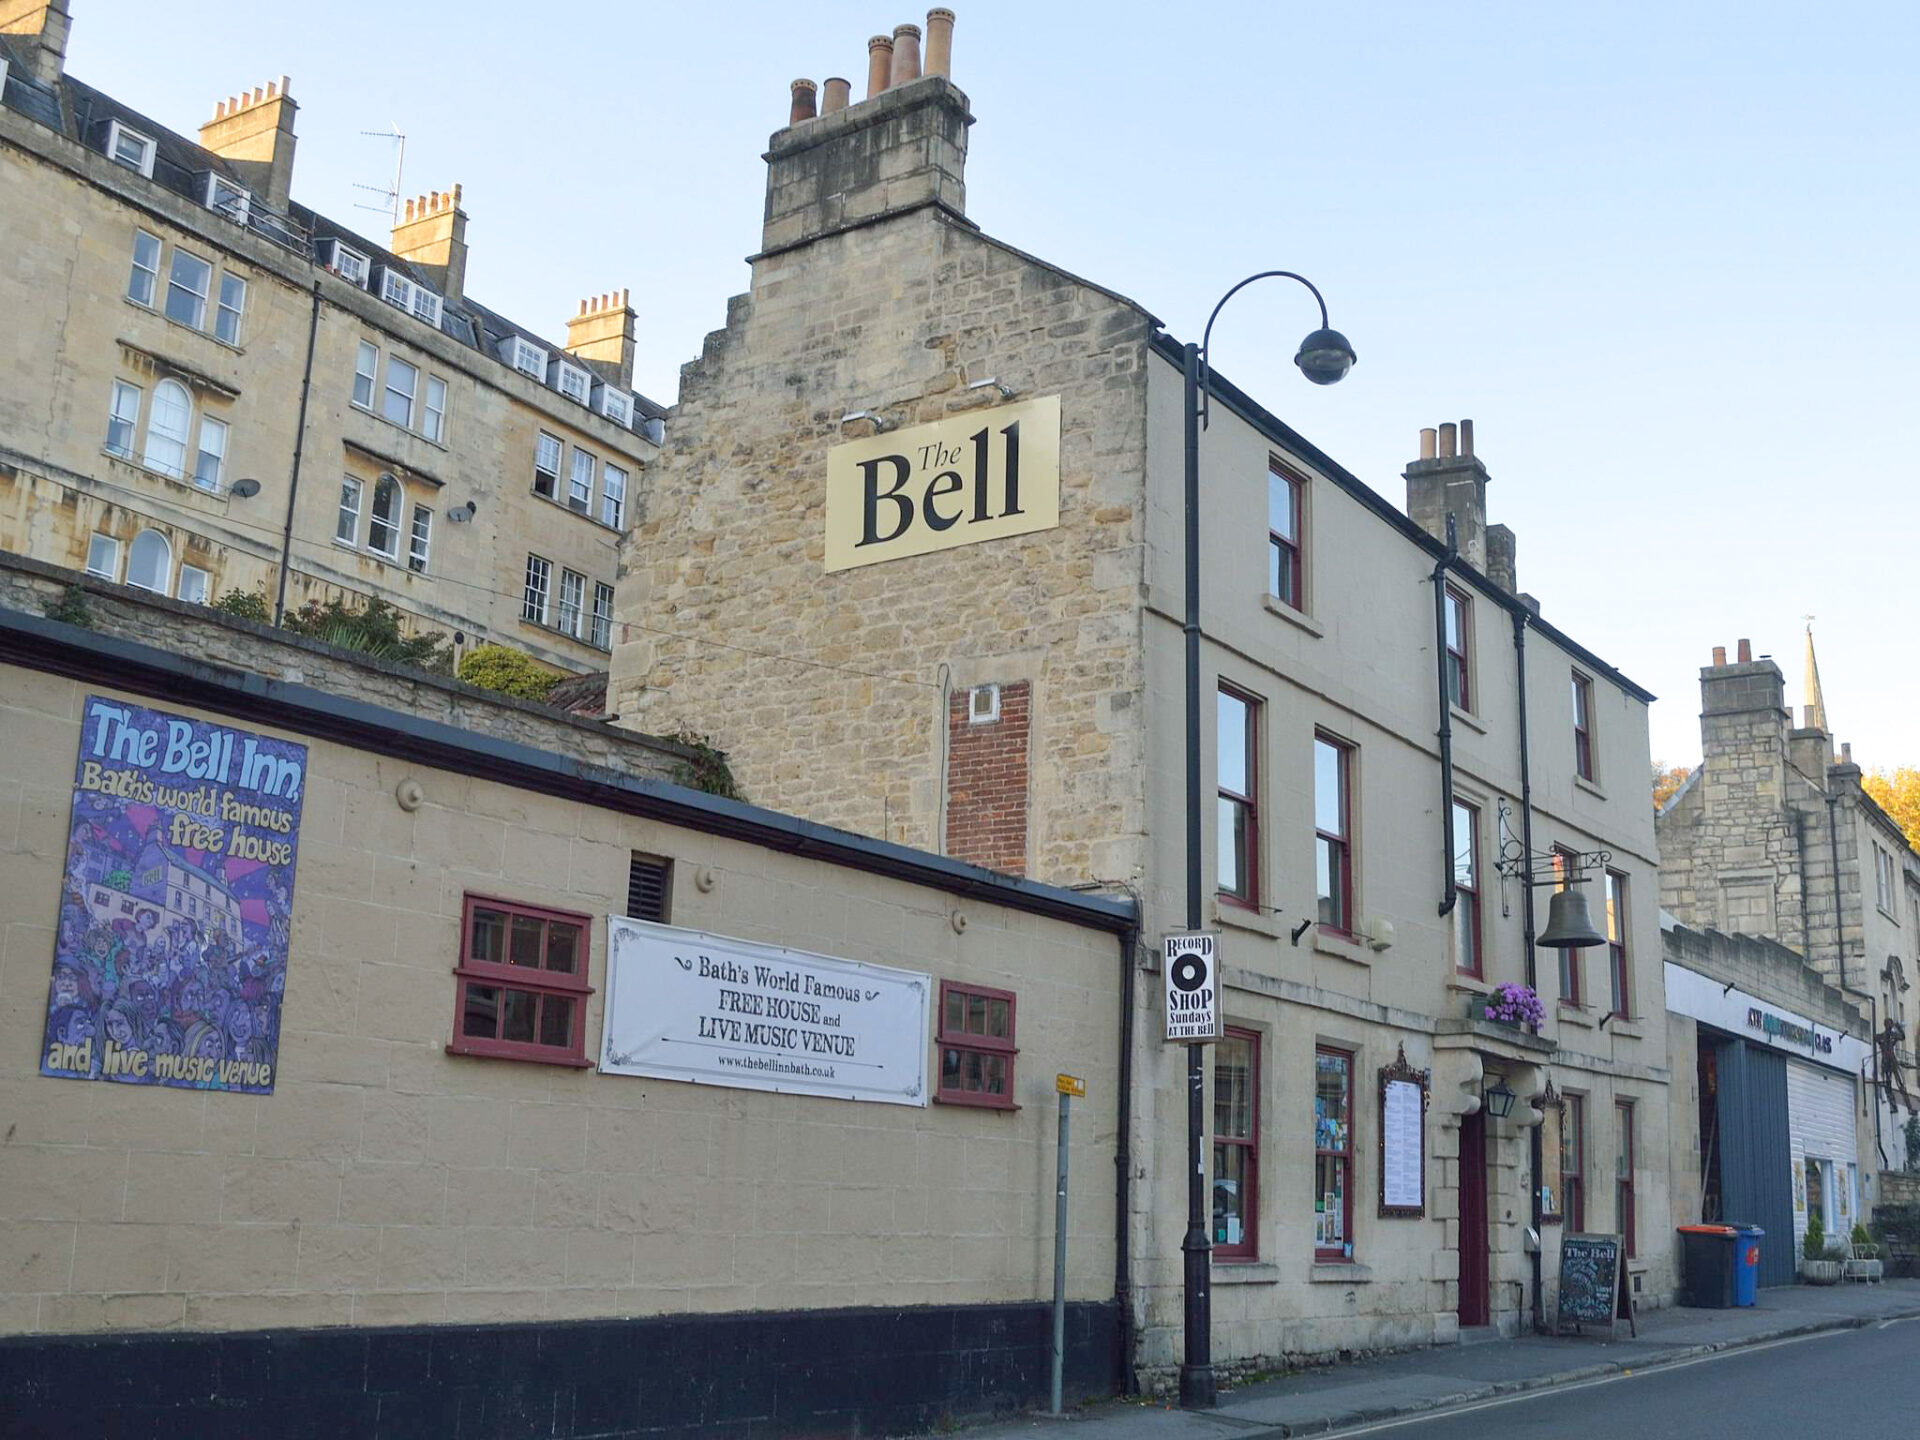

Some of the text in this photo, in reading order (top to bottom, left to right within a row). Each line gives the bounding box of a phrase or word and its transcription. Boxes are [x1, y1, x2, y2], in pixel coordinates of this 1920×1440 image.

[918, 441, 962, 471] The
[854, 419, 1025, 548] Bell
[90, 702, 158, 768] The
[160, 719, 234, 784] Bell
[157, 786, 217, 817] world
[221, 791, 293, 833] famous
[169, 813, 292, 866] free house
[698, 955, 860, 1002] Bath's World Famous
[718, 989, 841, 1028] FREE HOUSE and
[1169, 988, 1213, 1011] SHOP
[1170, 1010, 1212, 1025] Sundays
[698, 1016, 855, 1057] LIVE MUSIC VENUE
[1180, 1025, 1195, 1036] THE
[47, 1037, 271, 1086] and live music venue
[718, 1055, 835, 1079] www.thebellinnbath.co.uk
[1565, 1247, 1615, 1259] The Bell
